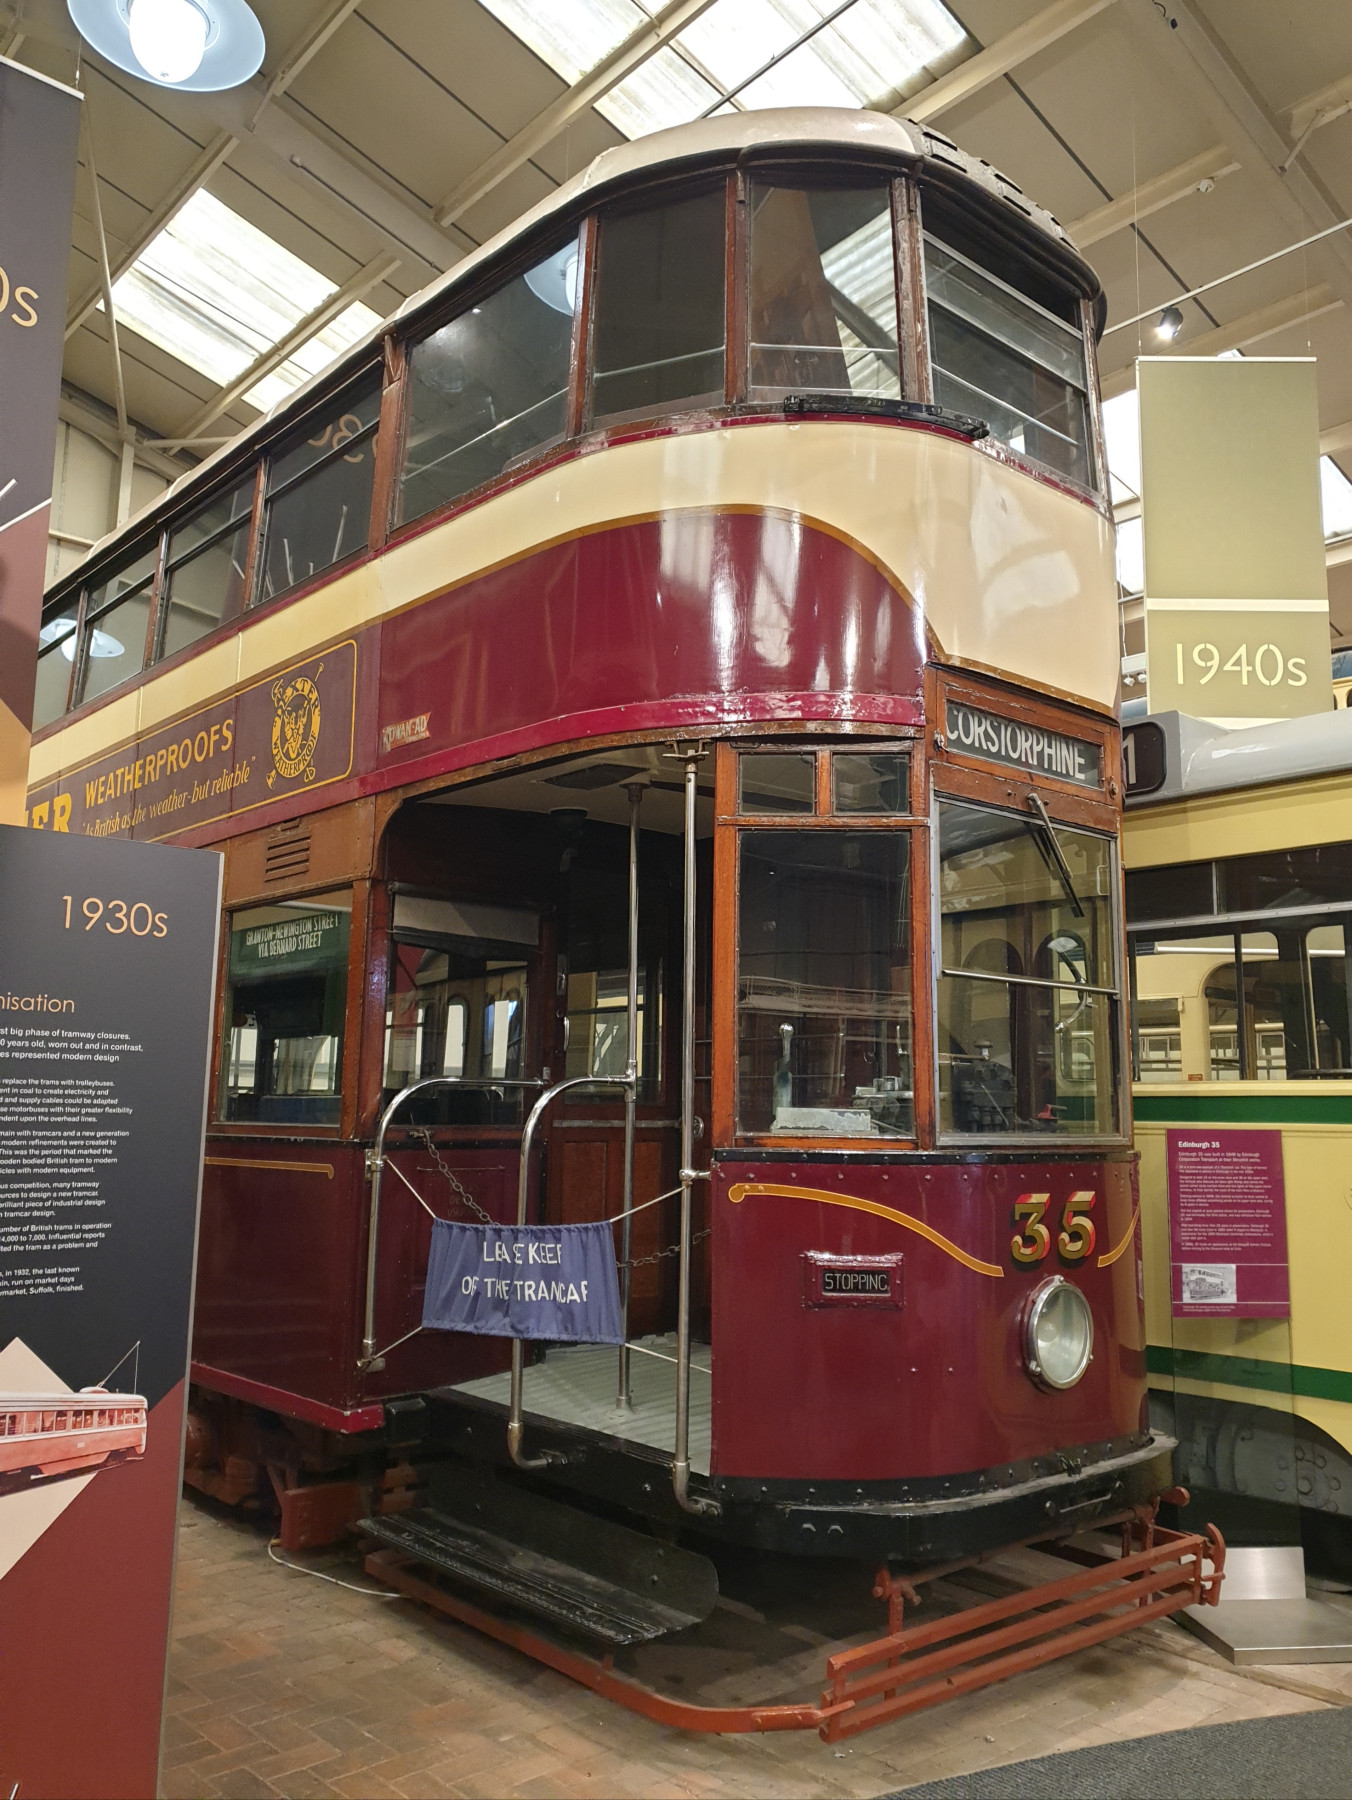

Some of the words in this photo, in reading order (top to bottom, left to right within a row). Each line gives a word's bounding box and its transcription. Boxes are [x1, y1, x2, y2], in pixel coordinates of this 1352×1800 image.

[1176, 643, 1308, 687] 1940s
[85, 719, 233, 809] WEATHERPROOFS
[121, 814, 132, 829] as
[131, 804, 146, 827] the
[61, 895, 168, 938] 1930s
[258, 942, 268, 958] VIA
[270, 936, 296, 955] BERNARD
[298, 931, 322, 950] STREET
[10, 1028, 23, 1036] big
[26, 1029, 49, 1037] phase
[62, 1030, 95, 1039] tramway
[97, 1032, 130, 1040] closures.
[31, 1040, 45, 1048] old,
[85, 1042, 99, 1050] and
[111, 1044, 143, 1052] contrast,
[12, 1052, 59, 1060] represented
[94, 1054, 119, 1062] design
[97, 1130, 129, 1138] generation
[1178, 1141, 1210, 1149] Edinburgh
[1010, 1190, 1096, 1263] 35
[58, 1242, 84, 1250] problem
[56, 1284, 84, 1292] finished.
[484, 1278, 510, 1299] THE
